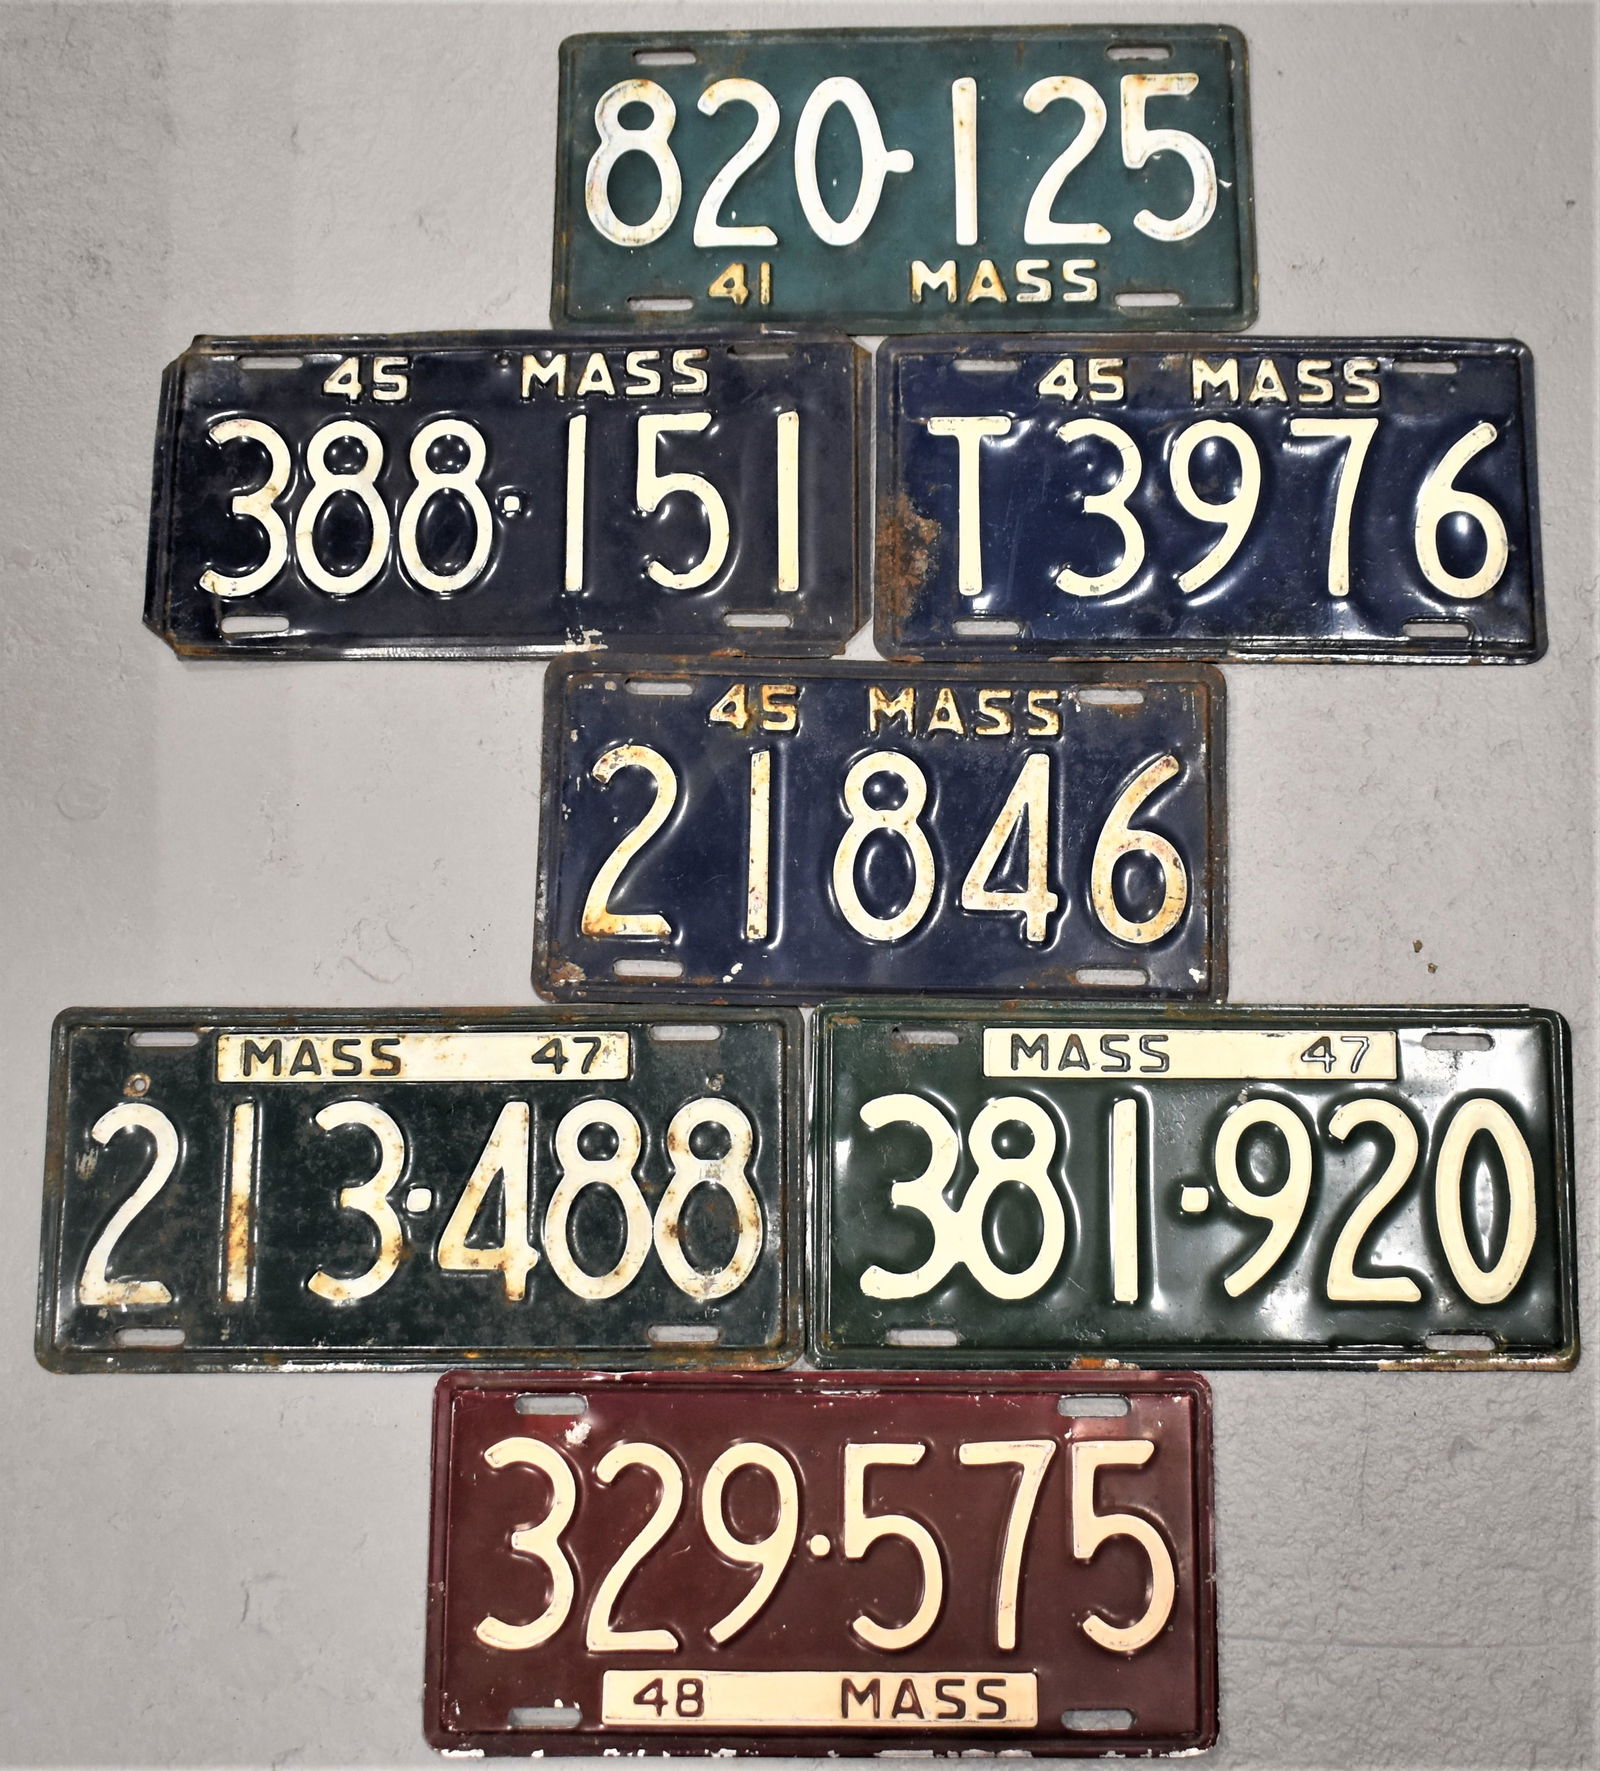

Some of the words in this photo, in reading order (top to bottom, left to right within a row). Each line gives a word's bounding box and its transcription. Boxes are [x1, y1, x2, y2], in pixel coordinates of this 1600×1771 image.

[585, 72, 1217, 246] 820-125
[709, 262, 770, 304] 41
[911, 259, 1098, 304] MASS
[323, 356, 409, 401] 45
[521, 350, 709, 398] MASS
[1037, 358, 1125, 402] 45
[1191, 358, 1381, 404] MASS
[927, 415, 1508, 598] T3976
[708, 683, 799, 732] 45
[869, 686, 1060, 737] MASS
[580, 744, 1187, 945] 21846
[242, 1037, 402, 1077] MASS
[531, 1036, 602, 1075] 47
[1010, 1033, 1171, 1073] MASS
[1299, 1034, 1371, 1073] 47
[632, 1678, 706, 1719] 48
[840, 1678, 1009, 1719] MASS
